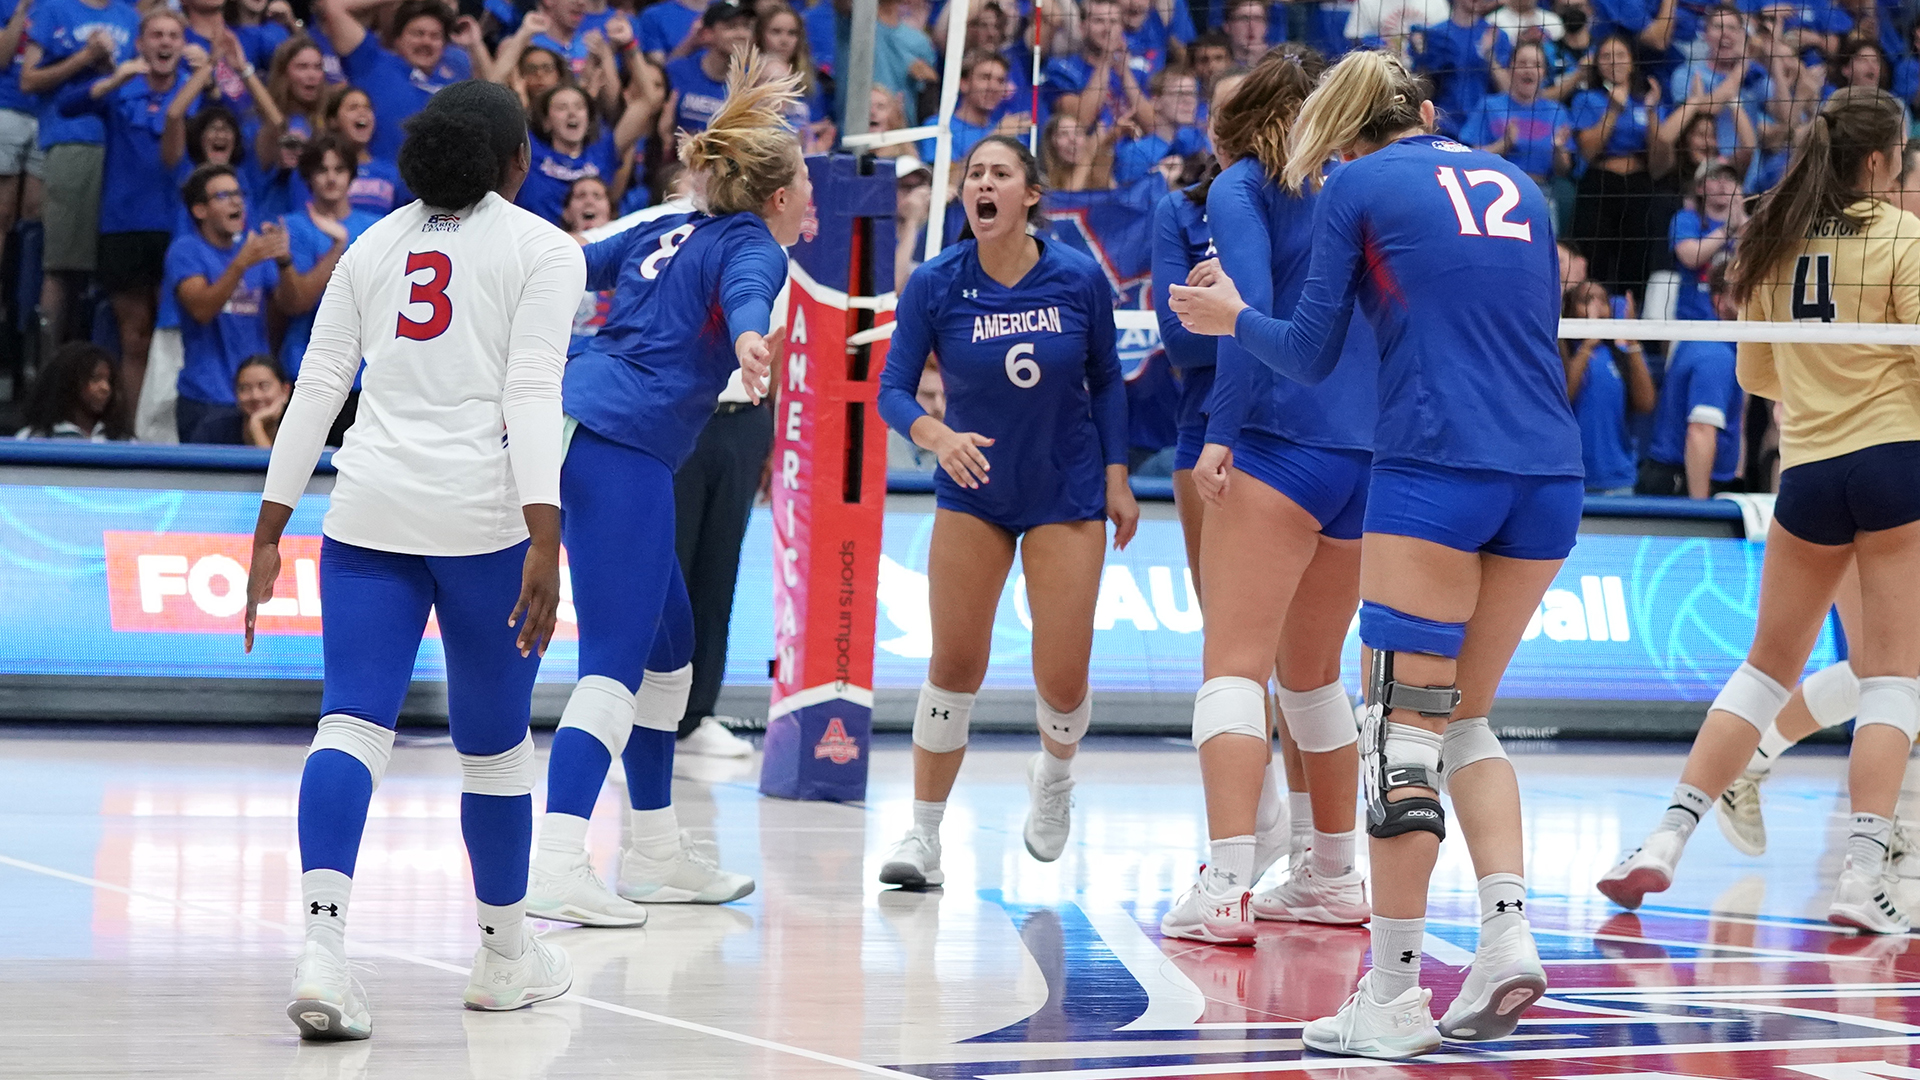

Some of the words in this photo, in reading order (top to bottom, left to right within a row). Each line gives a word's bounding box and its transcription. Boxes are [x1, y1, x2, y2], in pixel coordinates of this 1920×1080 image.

[1434, 165, 1533, 243] 12
[640, 223, 696, 280] 8
[395, 249, 453, 341] 3
[1792, 253, 1836, 322] 4
[971, 306, 1063, 344] AMERICAN
[1004, 342, 1042, 389] 6
[777, 303, 808, 685] AMERICAN
[838, 540, 855, 607] sports
[834, 611, 852, 692] imports
